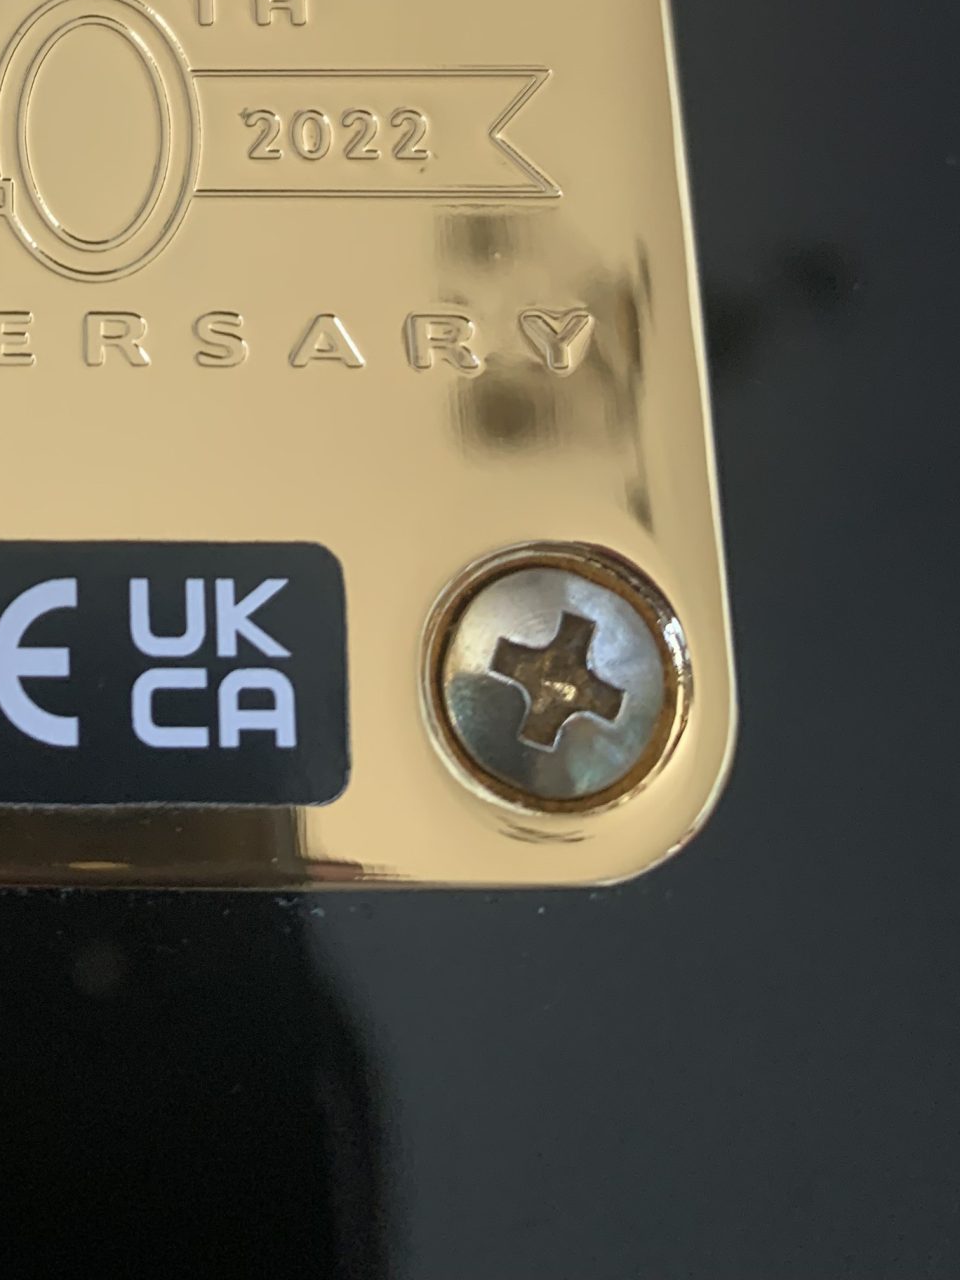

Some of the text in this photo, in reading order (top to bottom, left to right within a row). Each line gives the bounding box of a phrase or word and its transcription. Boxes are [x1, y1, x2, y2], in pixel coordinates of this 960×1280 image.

[242, 109, 431, 160] 2022
[129, 578, 292, 658] UK
[131, 668, 297, 748] CA
